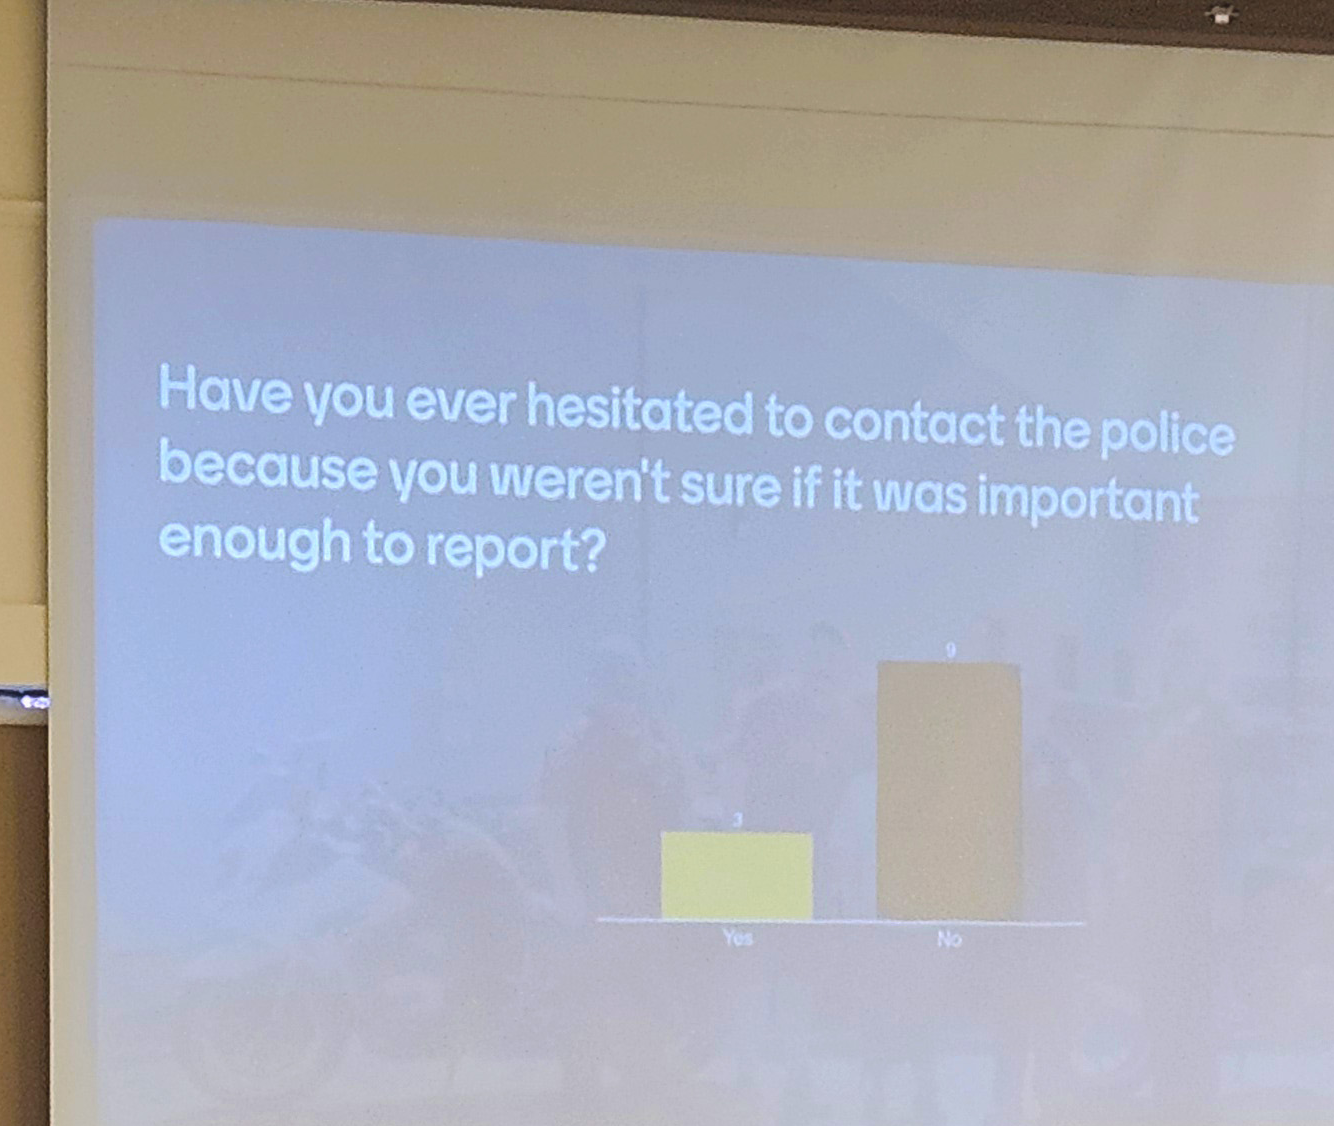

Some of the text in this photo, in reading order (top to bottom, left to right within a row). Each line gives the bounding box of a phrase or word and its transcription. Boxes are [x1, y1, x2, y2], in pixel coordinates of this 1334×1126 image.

[159, 362, 1237, 461] Have you ever hesitated to contact the police
[159, 436, 1201, 529] because you weren't sure if it was important
[158, 516, 608, 579] enough to report?
[732, 811, 743, 828] 3
[723, 928, 754, 946] Yes
[937, 930, 963, 948] No
